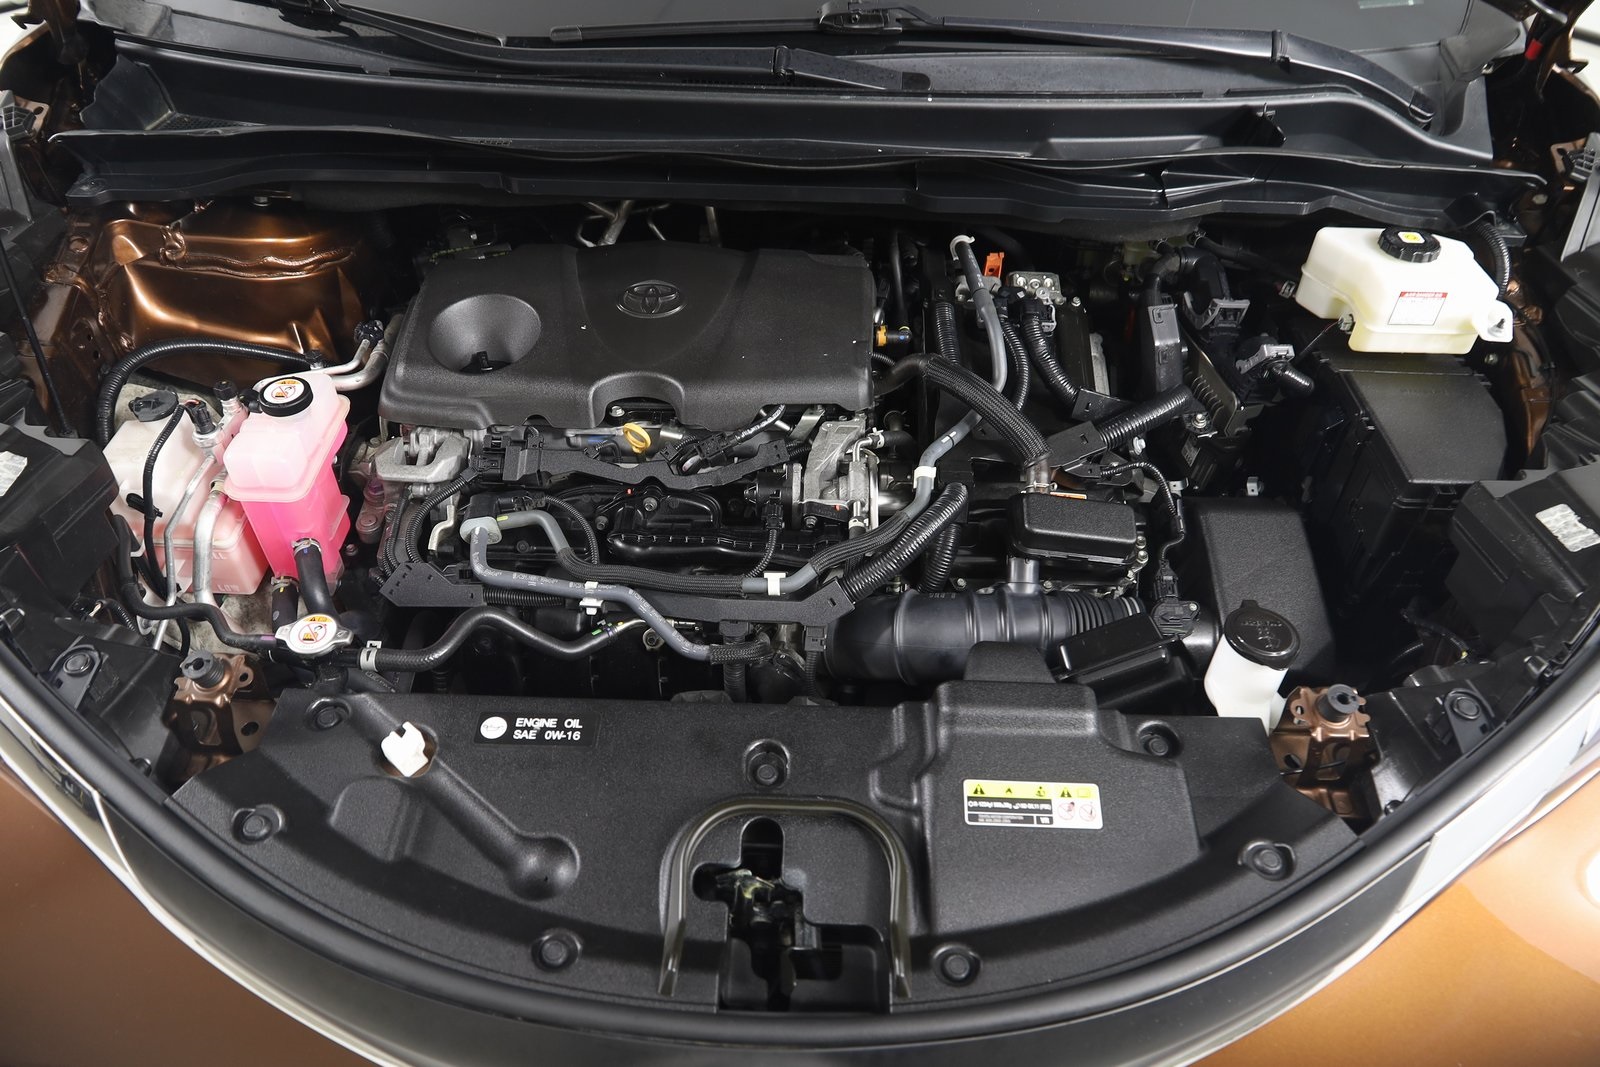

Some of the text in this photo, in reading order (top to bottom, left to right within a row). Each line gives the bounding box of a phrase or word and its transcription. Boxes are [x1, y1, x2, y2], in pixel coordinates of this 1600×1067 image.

[515, 717, 583, 729] ENGINE OIL
[512, 729, 581, 741] SAE 0W-16
